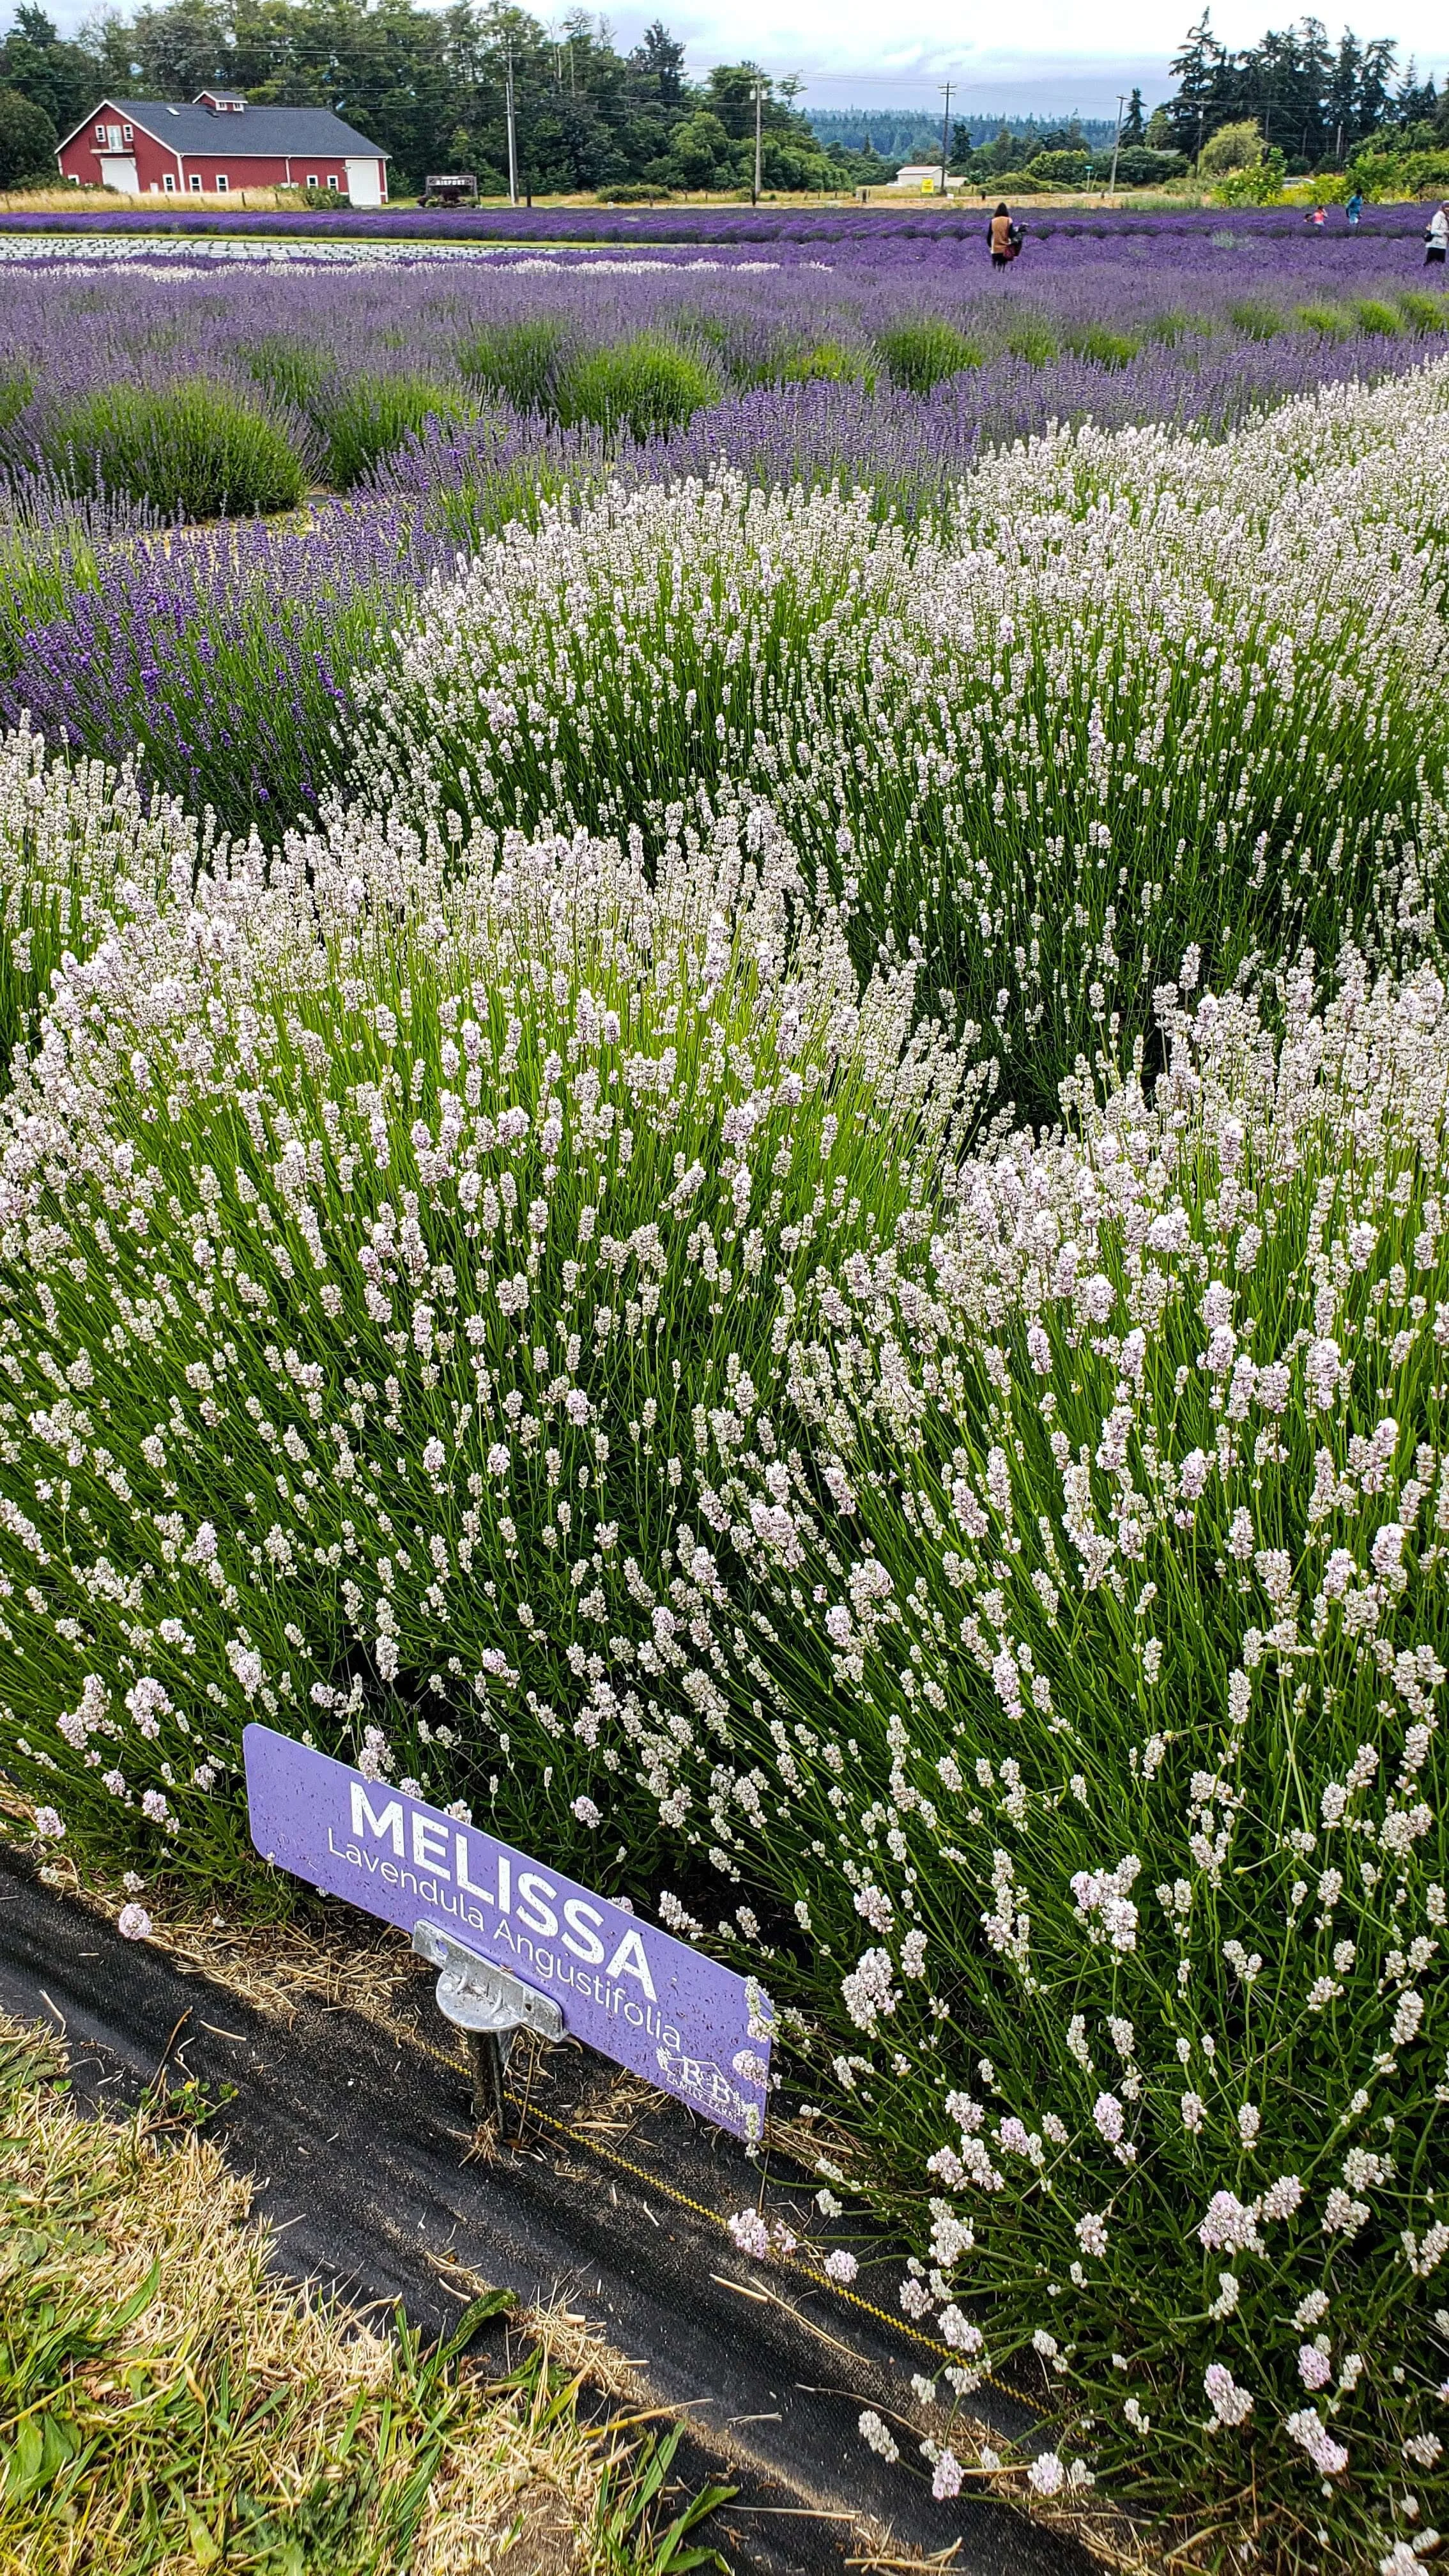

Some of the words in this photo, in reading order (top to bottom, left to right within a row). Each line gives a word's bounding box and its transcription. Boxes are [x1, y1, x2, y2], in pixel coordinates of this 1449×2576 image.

[328, 1827, 484, 1931] Lavendula
[493, 1919, 680, 2052] Angustifolia
[351, 1781, 657, 2002] MELISSA
[666, 2073, 703, 2103] FAMILY
[682, 2055, 730, 2104] B&B
